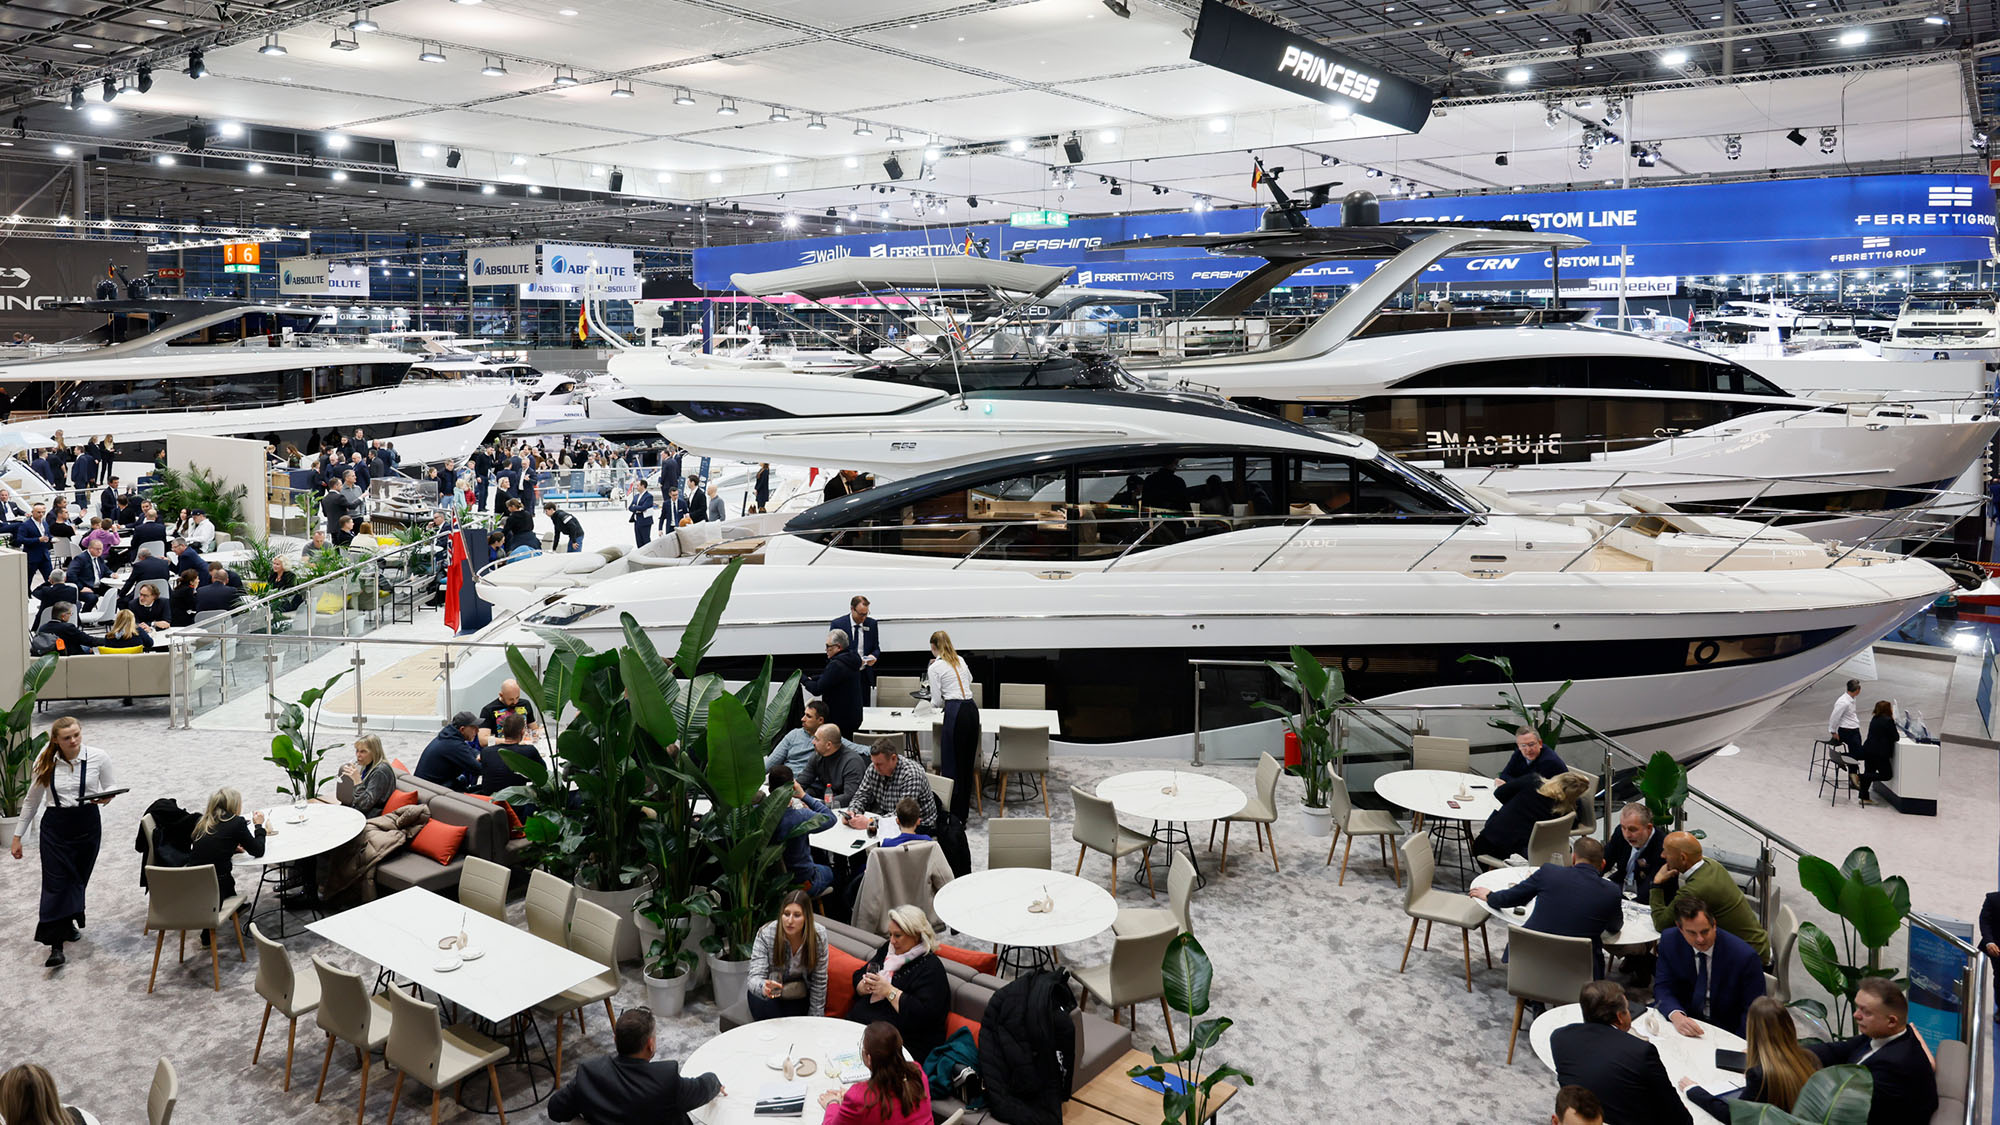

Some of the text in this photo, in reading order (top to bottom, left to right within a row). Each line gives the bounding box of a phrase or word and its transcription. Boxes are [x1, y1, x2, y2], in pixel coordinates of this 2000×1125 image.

[1278, 45, 1380, 103] PRINCESS
[1588, 209, 1638, 228] LINE
[1012, 237, 1102, 250] PERSHING
[227, 247, 233, 262] 6
[243, 247, 253, 262] 6
[1830, 247, 1927, 262] FERRETTIGROUP
[485, 263, 529, 276] ABSOLUTE
[1466, 258, 1520, 270] CRN
[292, 275, 324, 285] ABSOLUTE
[1094, 271, 1175, 282] FERRETTIYACHTS
[1191, 269, 1257, 280] PERSHIN
[537, 285, 580, 294] ABSOLUTE
[607, 285, 636, 293] BSOLUTE
[1589, 279, 1673, 292] Suneeker
